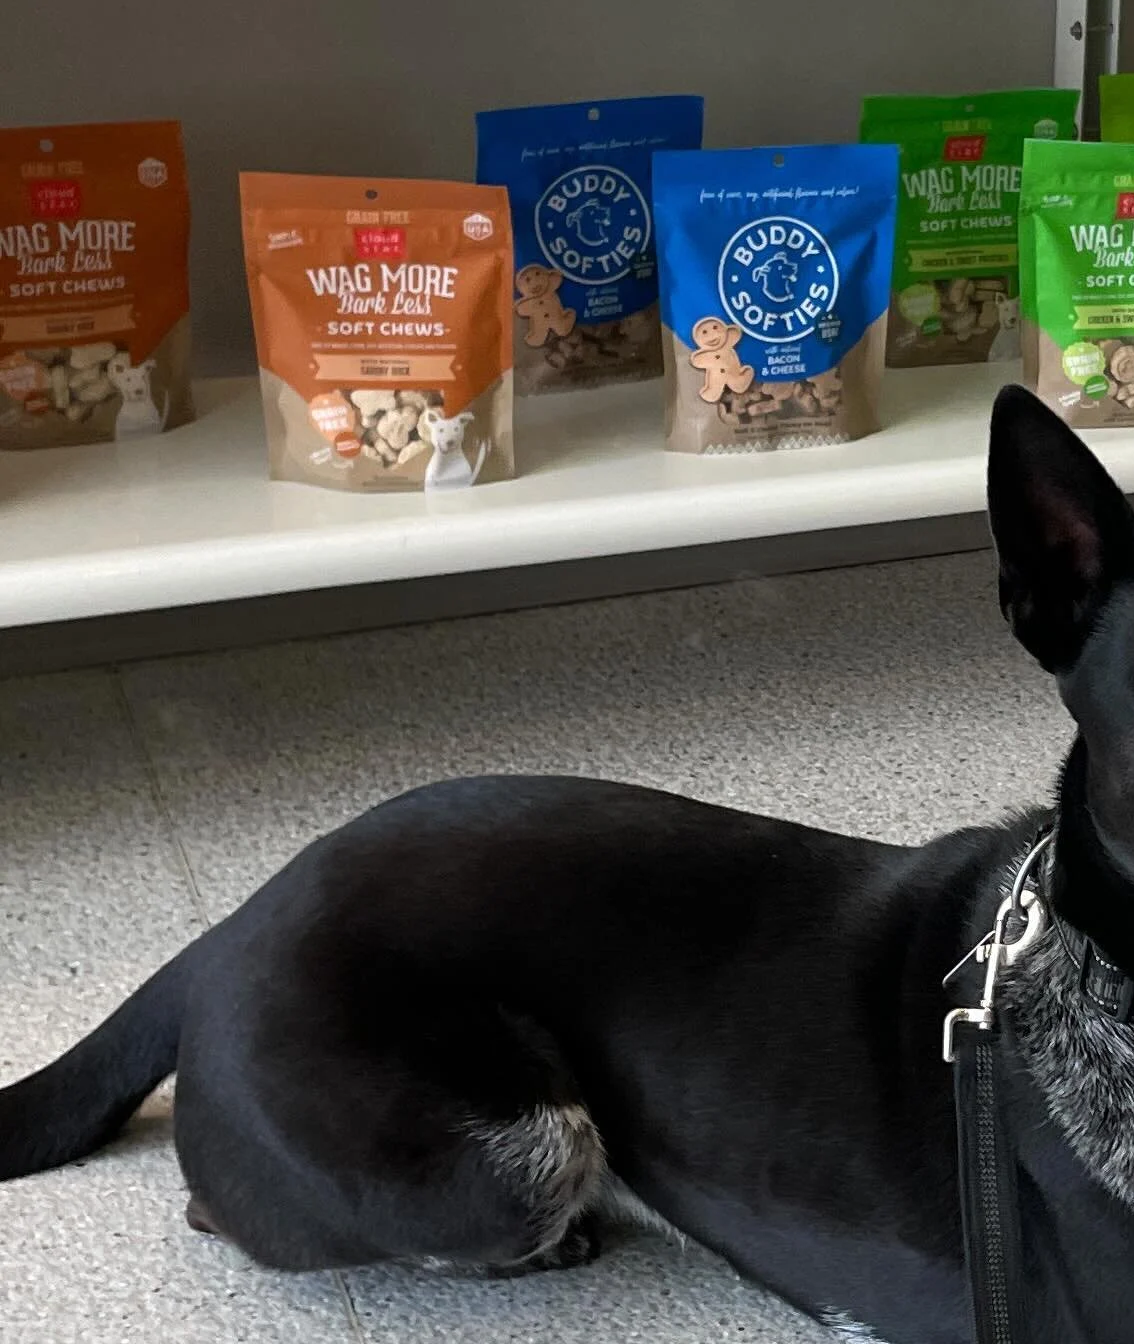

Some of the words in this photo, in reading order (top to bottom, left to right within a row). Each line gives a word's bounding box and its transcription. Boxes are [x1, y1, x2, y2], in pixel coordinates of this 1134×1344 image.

[547, 174, 631, 213] BUDDY
[902, 167, 954, 199] WAG
[961, 165, 1022, 193] MORE
[346, 210, 380, 225] GRAIN
[383, 210, 409, 225] FREE
[920, 218, 957, 232] SOFT
[960, 215, 1013, 230] CHEWS
[58, 219, 136, 251] MORE
[733, 225, 820, 267] BUDDY
[1070, 223, 1124, 252] WAG
[550, 226, 642, 274] SOFTIES
[1093, 246, 1134, 268] Bark
[9, 280, 57, 298] SOFT
[62, 276, 126, 294] CHEWS
[306, 263, 370, 297] WAG
[380, 263, 459, 299] MORE
[1086, 275, 1125, 288] SOFT
[337, 291, 386, 315] Bark
[390, 291, 433, 316] Less
[731, 283, 830, 332] SOFTIES
[327, 321, 375, 336] SOFT
[380, 321, 445, 337] CHEWS
[761, 367, 769, 376] &
[771, 364, 806, 375] CHEESE
[768, 355, 800, 366] BACON
